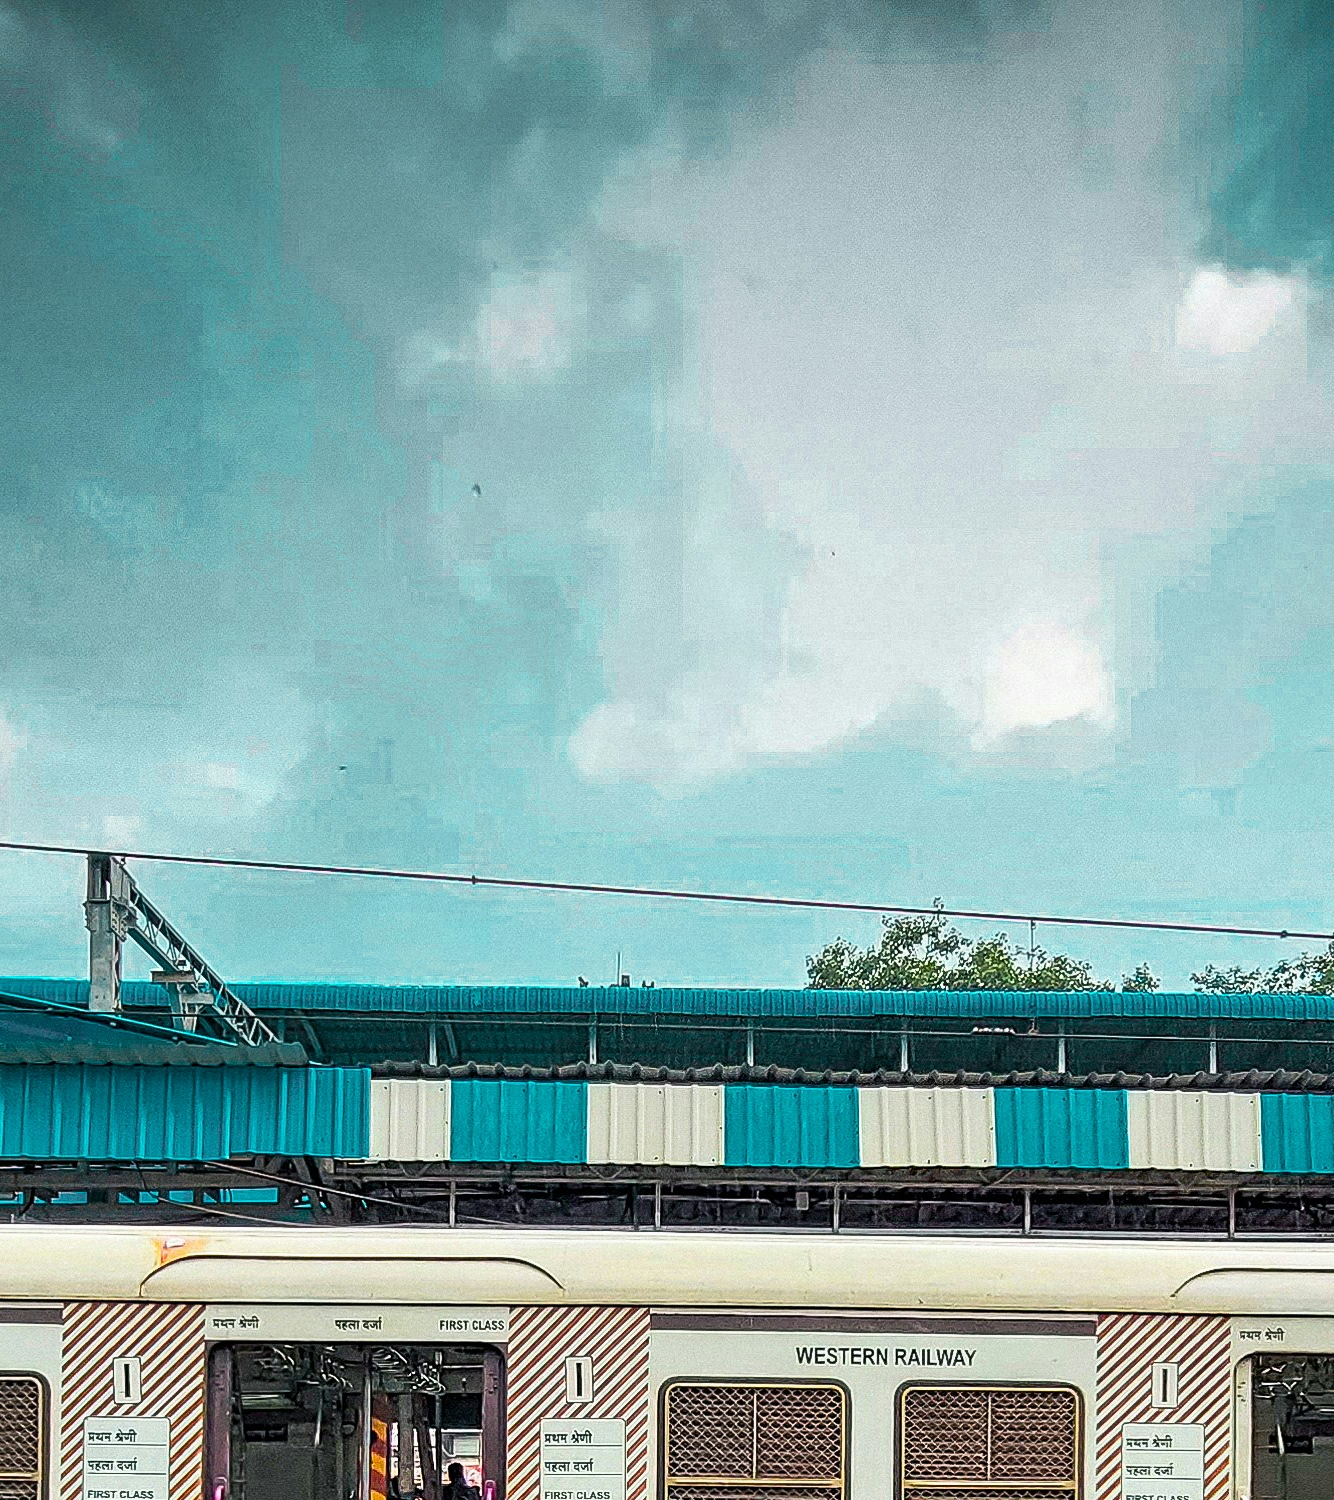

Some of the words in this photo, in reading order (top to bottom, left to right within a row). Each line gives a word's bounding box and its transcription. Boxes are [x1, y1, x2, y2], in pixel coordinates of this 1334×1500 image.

[334, 1319, 359, 1331] पहला
[362, 1316, 382, 1331] दर्जा
[439, 1320, 470, 1331] FIRST
[472, 1320, 505, 1331] CLASS
[796, 1347, 888, 1365] WESTERN
[895, 1349, 977, 1367] RAILWAY
[115, 1429, 137, 1443] श्रेणी
[544, 1433, 568, 1444] प्रथम
[571, 1430, 593, 1444] श्रेणी
[88, 1460, 114, 1471] पहला
[117, 1457, 138, 1471] दर्जा
[544, 1461, 570, 1472] पहला
[573, 1458, 594, 1472] दर्जा
[1126, 1466, 1151, 1476] पहला
[1154, 1463, 1174, 1476] दर्जा
[87, 1490, 117, 1499] FIRST
[119, 1490, 154, 1499] CLASS
[544, 1491, 574, 1500] FIRST
[576, 1491, 611, 1500] CLASS
